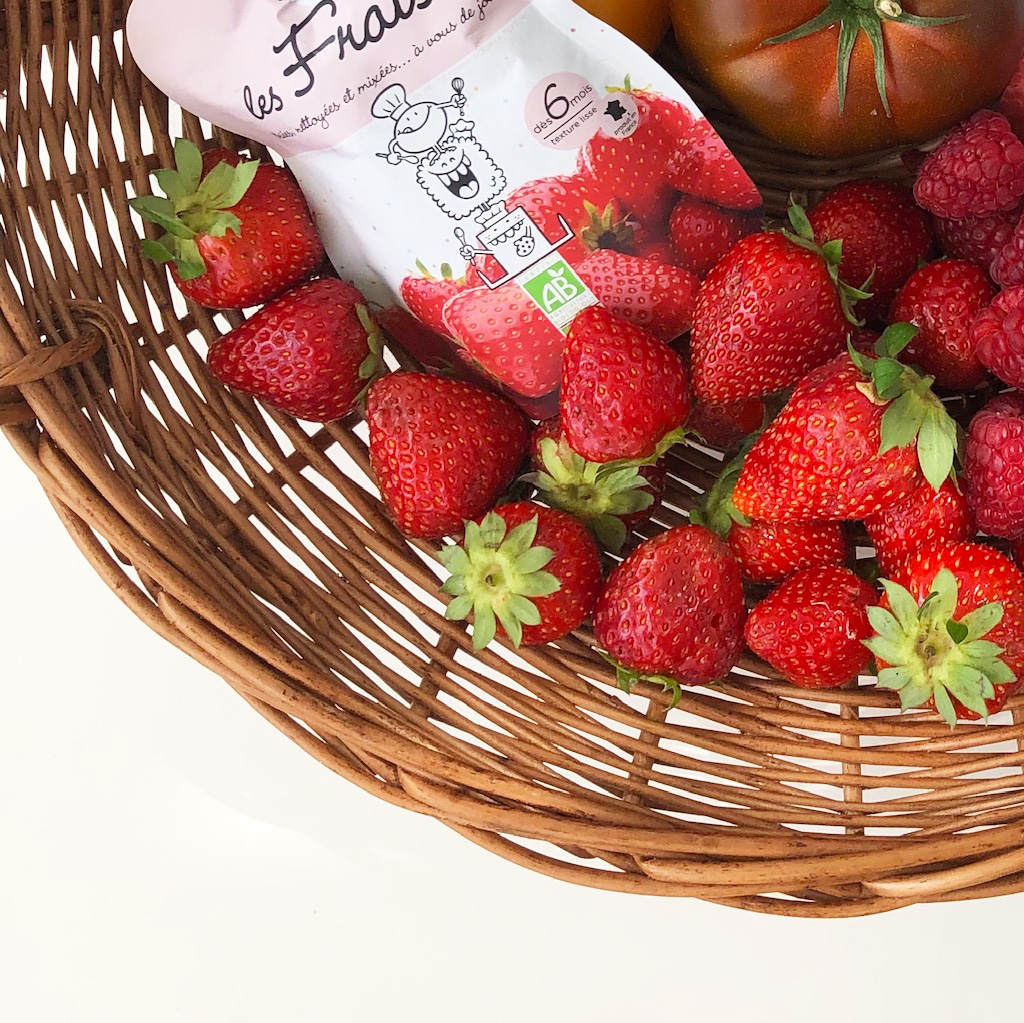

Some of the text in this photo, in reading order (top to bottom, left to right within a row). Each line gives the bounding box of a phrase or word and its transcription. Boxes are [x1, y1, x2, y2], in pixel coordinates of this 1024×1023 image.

[343, 87, 356, 104] et
[411, 44, 424, 57] à
[426, 22, 457, 47] vous
[460, 7, 475, 24] de
[243, 85, 284, 120] les
[533, 83, 593, 134] dès 6 mois
[550, 107, 598, 146] texture lisse
[542, 276, 578, 312] AB
